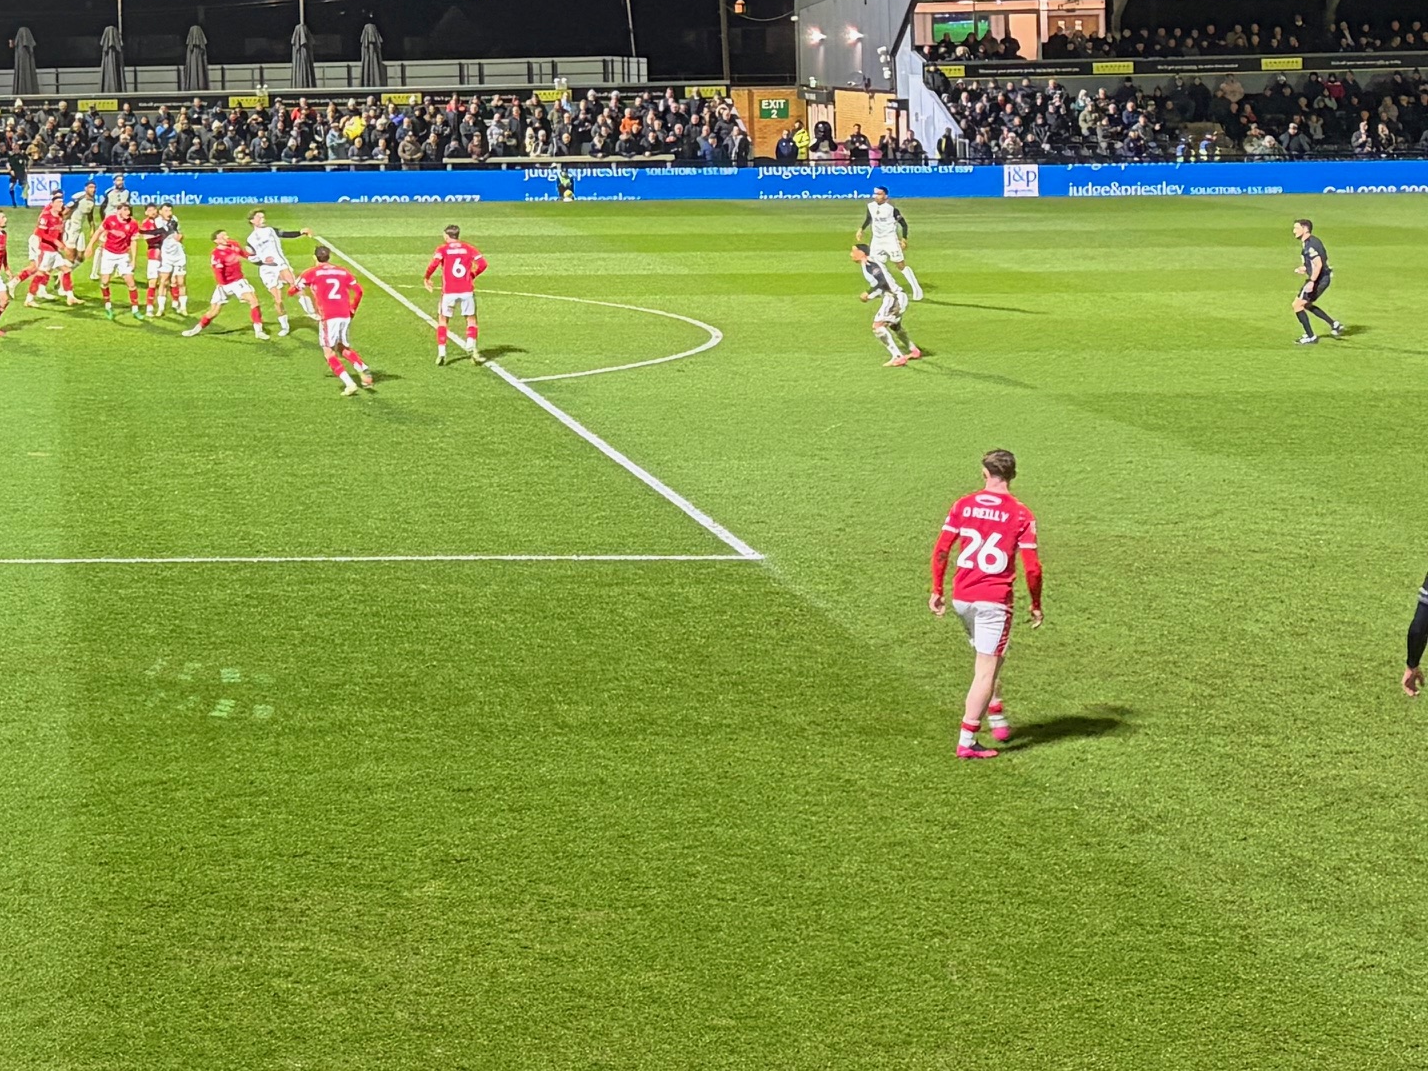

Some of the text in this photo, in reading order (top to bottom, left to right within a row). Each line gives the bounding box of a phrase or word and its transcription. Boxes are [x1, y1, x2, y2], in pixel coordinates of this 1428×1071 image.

[761, 100, 786, 109] EXIT
[770, 110, 778, 119] 2
[1006, 165, 1037, 187] j&p
[1068, 181, 1184, 197] judge&priestley
[452, 258, 467, 278] 6
[326, 279, 342, 300] 2
[957, 527, 1008, 575] 26
